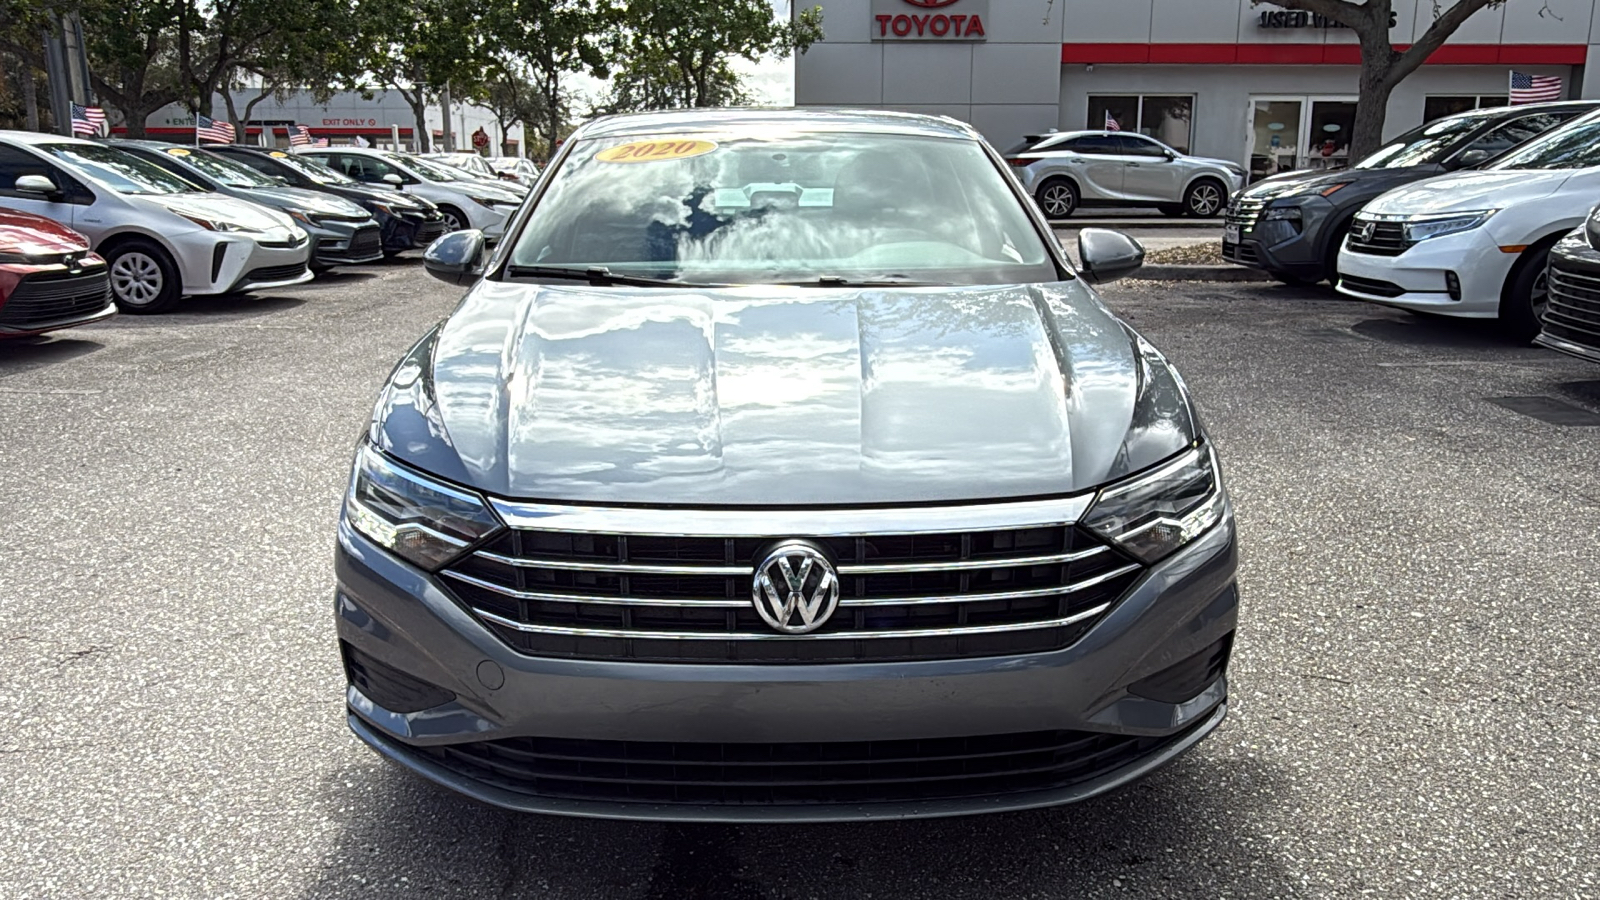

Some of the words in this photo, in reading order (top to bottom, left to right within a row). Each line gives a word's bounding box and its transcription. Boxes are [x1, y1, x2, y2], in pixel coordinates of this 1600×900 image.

[875, 14, 985, 37] TOYOTA
[1260, 11, 1308, 28] USED
[172, 118, 197, 126] ENTE
[322, 118, 340, 126] EXIT
[342, 118, 365, 126] ONLY
[610, 141, 697, 160] 2020
[756, 548, 836, 631] VW
